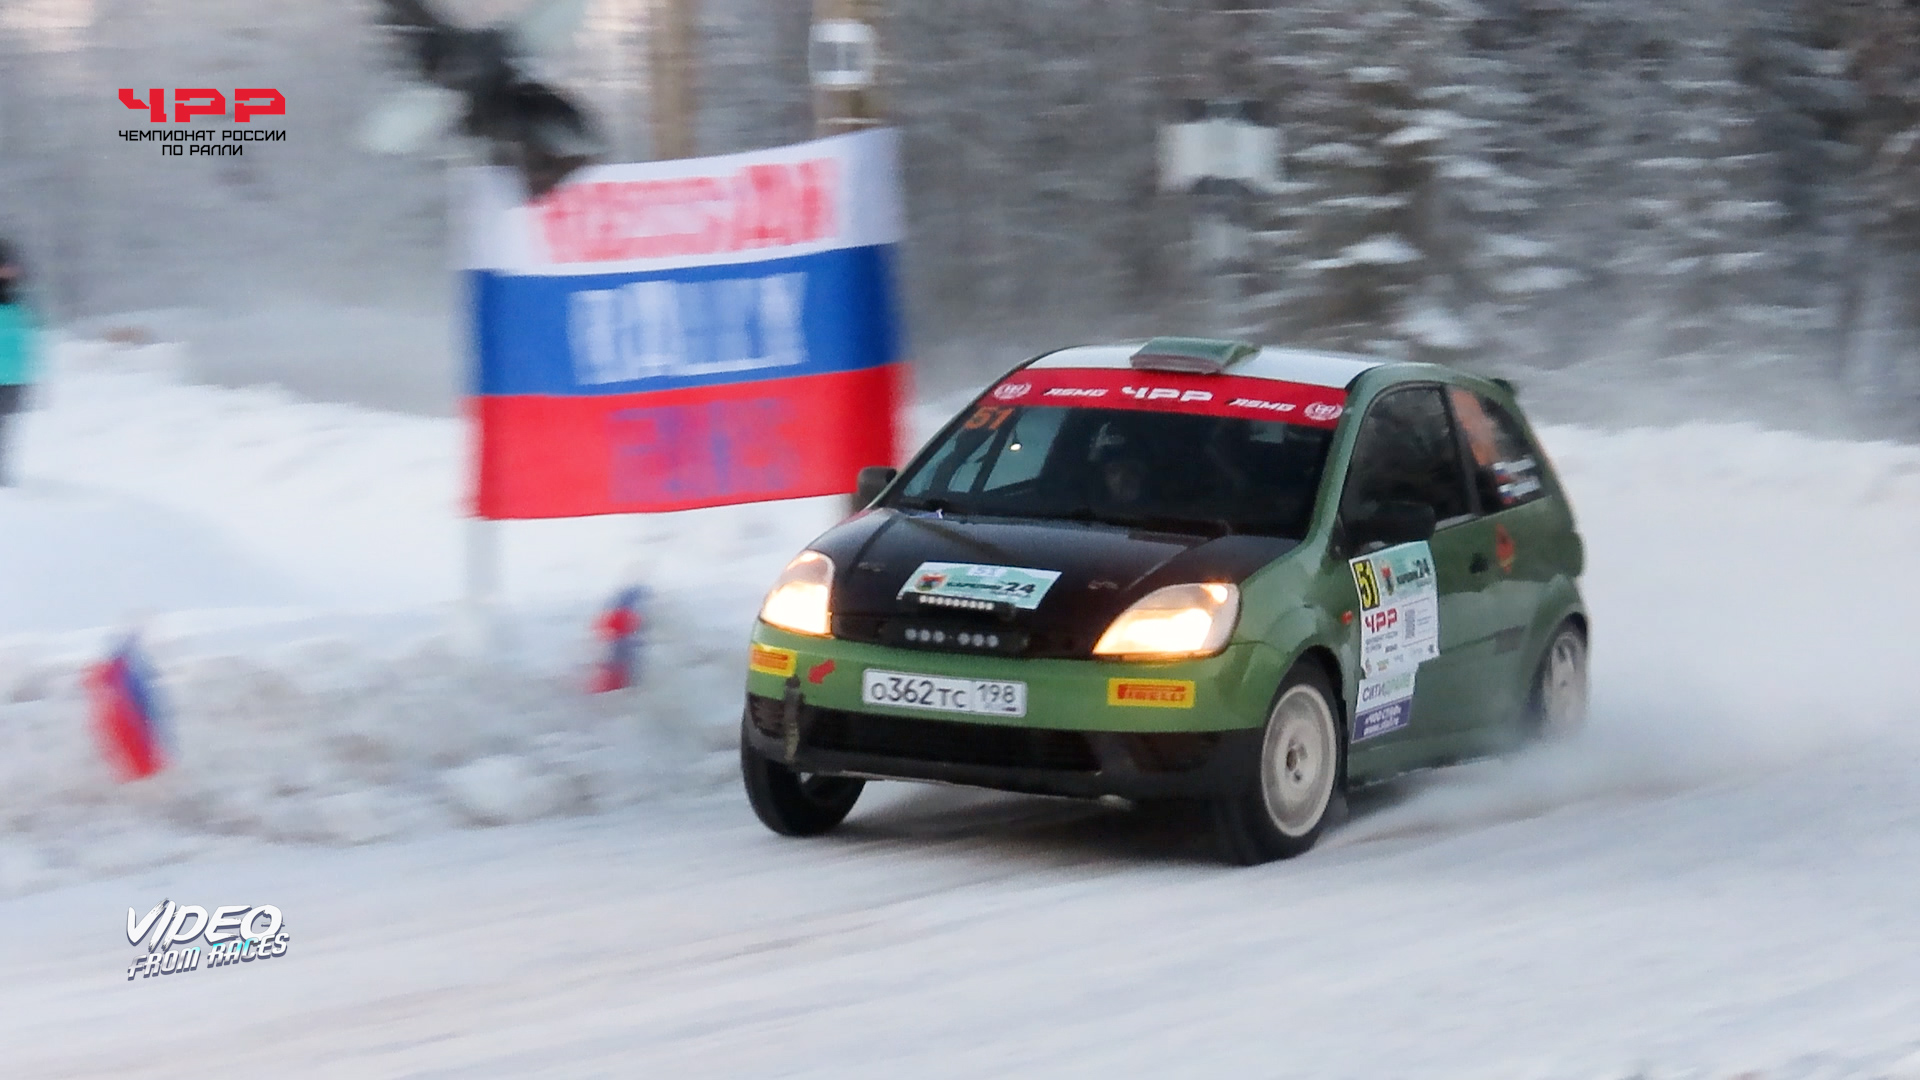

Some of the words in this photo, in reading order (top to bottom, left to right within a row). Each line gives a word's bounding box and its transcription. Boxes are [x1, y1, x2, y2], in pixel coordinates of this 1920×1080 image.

[1121, 386, 1213, 401] ЧРР
[963, 406, 1013, 430] 51
[1354, 560, 1379, 609] 51
[1364, 607, 1398, 634] ЧРР
[977, 683, 1017, 704] 198
